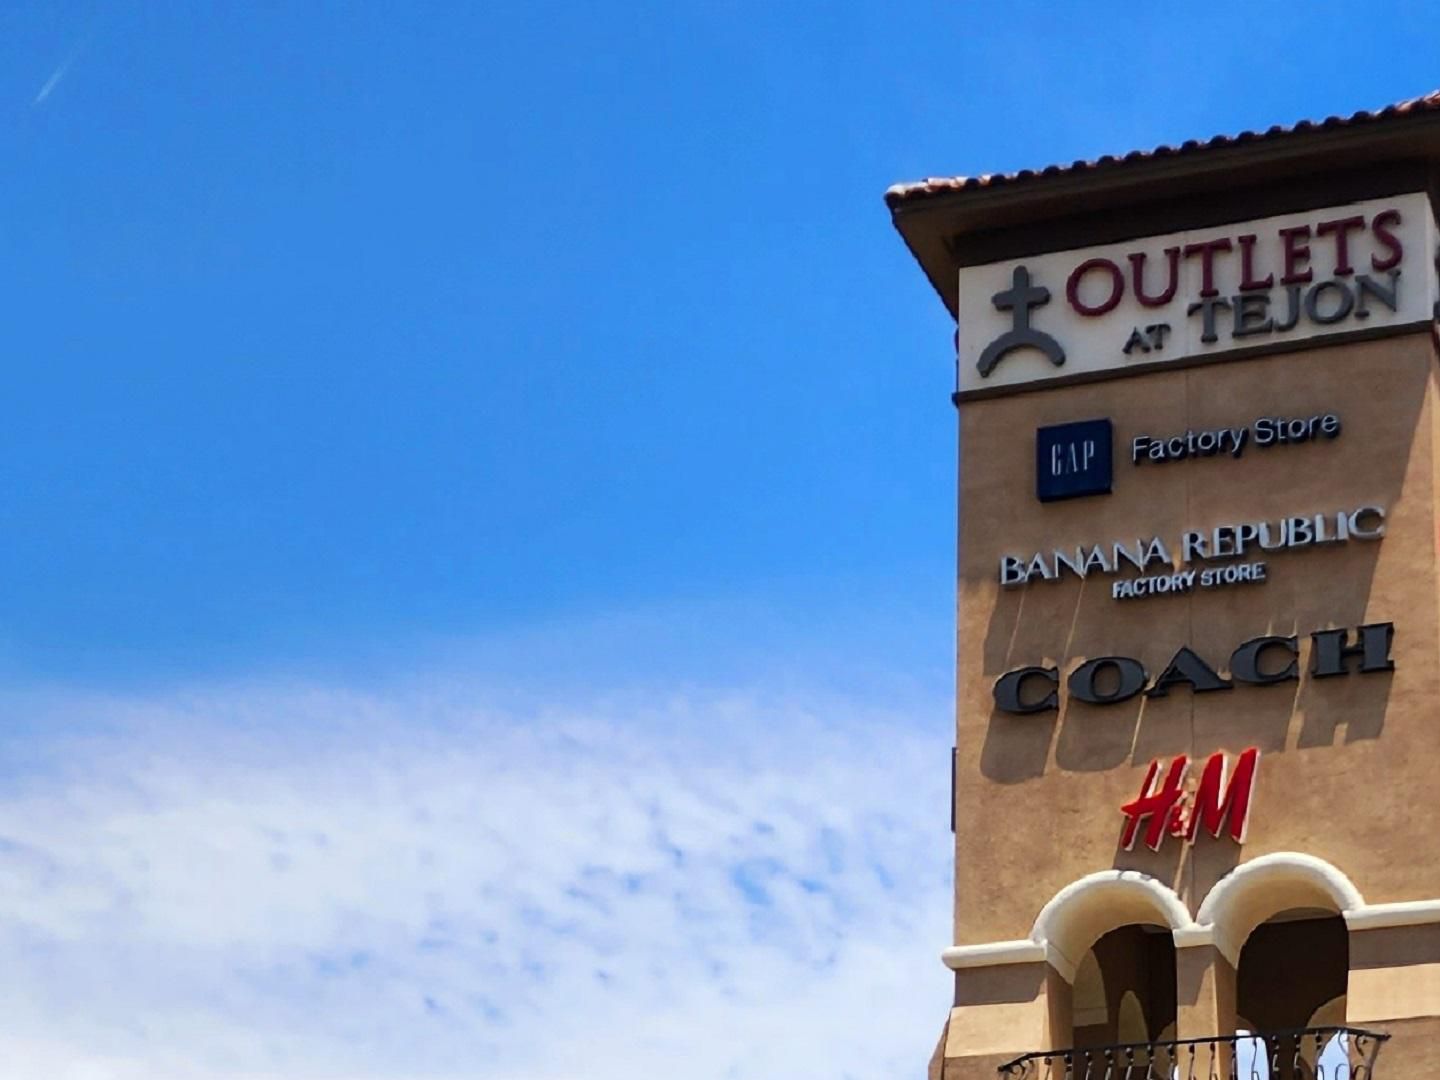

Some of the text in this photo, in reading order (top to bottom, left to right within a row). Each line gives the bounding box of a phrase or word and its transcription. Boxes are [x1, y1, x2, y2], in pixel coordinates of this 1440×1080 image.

[1066, 209, 1403, 317] OUTLETS
[1122, 269, 1402, 354] AT TEJON
[1051, 413, 1340, 476] GAP Factory Store
[1000, 506, 1386, 586] BANANA REPUBLIC
[1112, 562, 1267, 601] FACTORY STORE
[992, 621, 1396, 714] COACH
[1120, 746, 1261, 852] H&M
